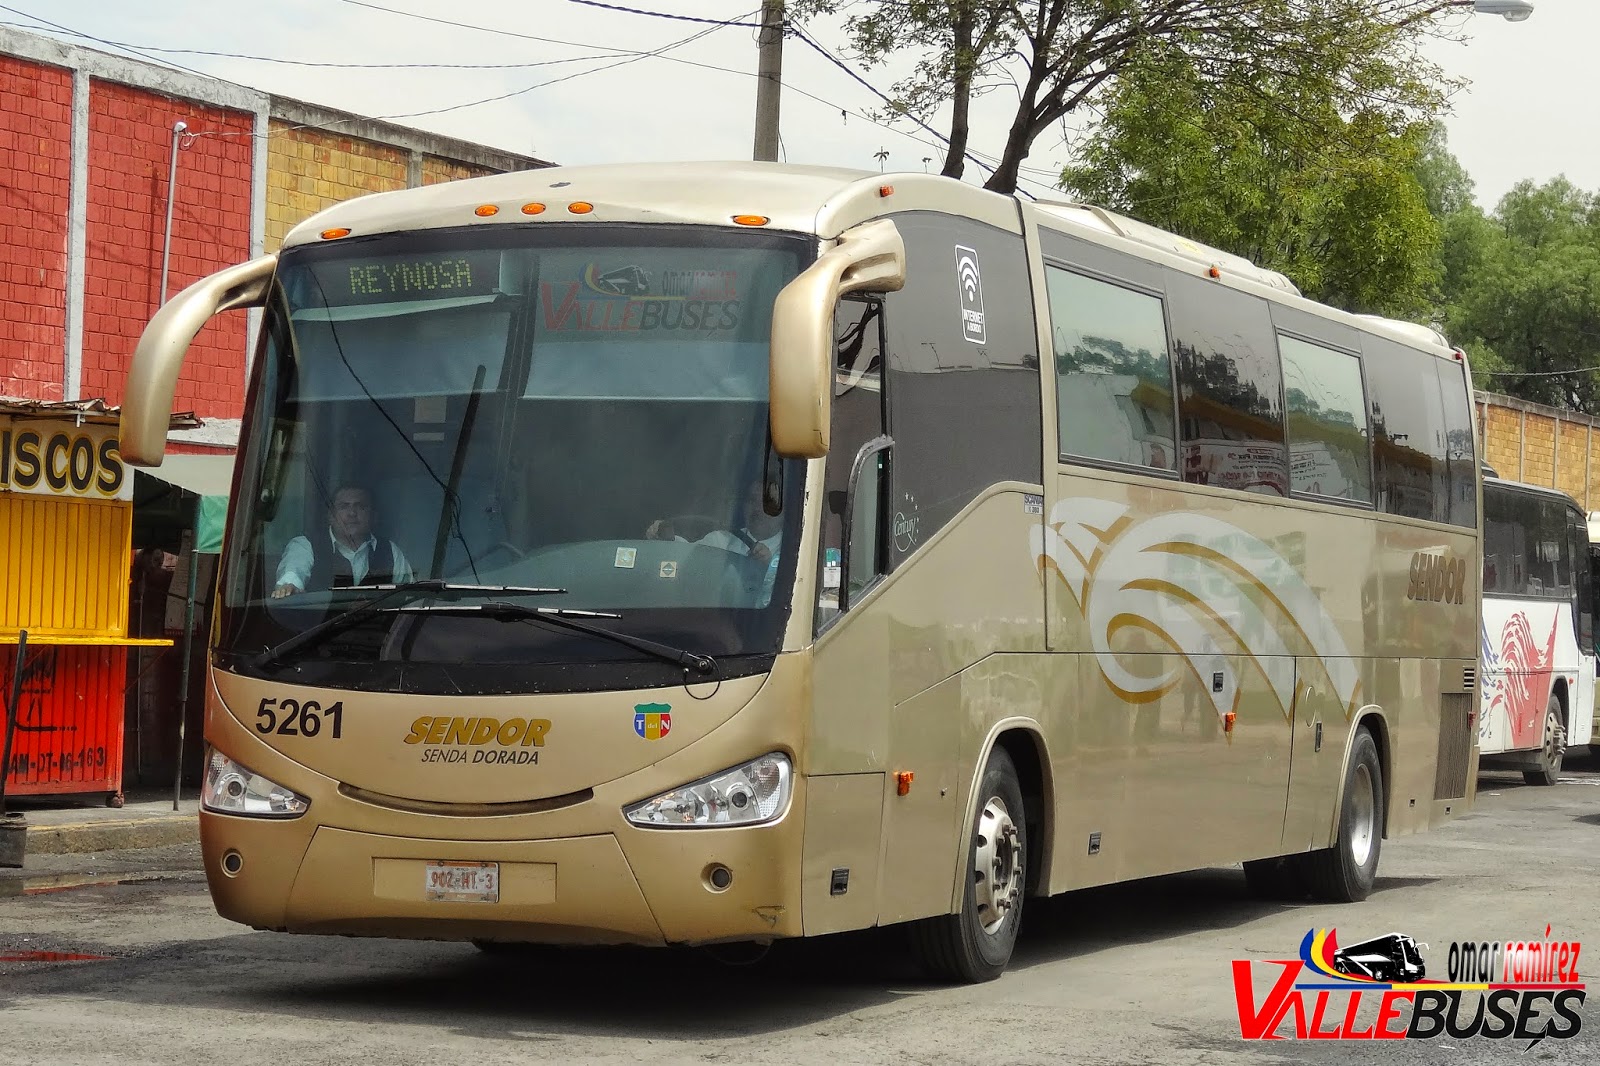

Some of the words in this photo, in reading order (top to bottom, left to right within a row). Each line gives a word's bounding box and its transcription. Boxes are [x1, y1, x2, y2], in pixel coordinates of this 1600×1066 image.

[350, 259, 472, 294] REYNOSA
[963, 309, 984, 324] INTERNET
[1407, 552, 1466, 604] SENDOR
[255, 697, 344, 739] 5261
[403, 716, 553, 747] SENDOR
[636, 719, 645, 730] T
[661, 719, 670, 730] N
[421, 749, 467, 764] SENDA
[472, 750, 539, 765] DORADA
